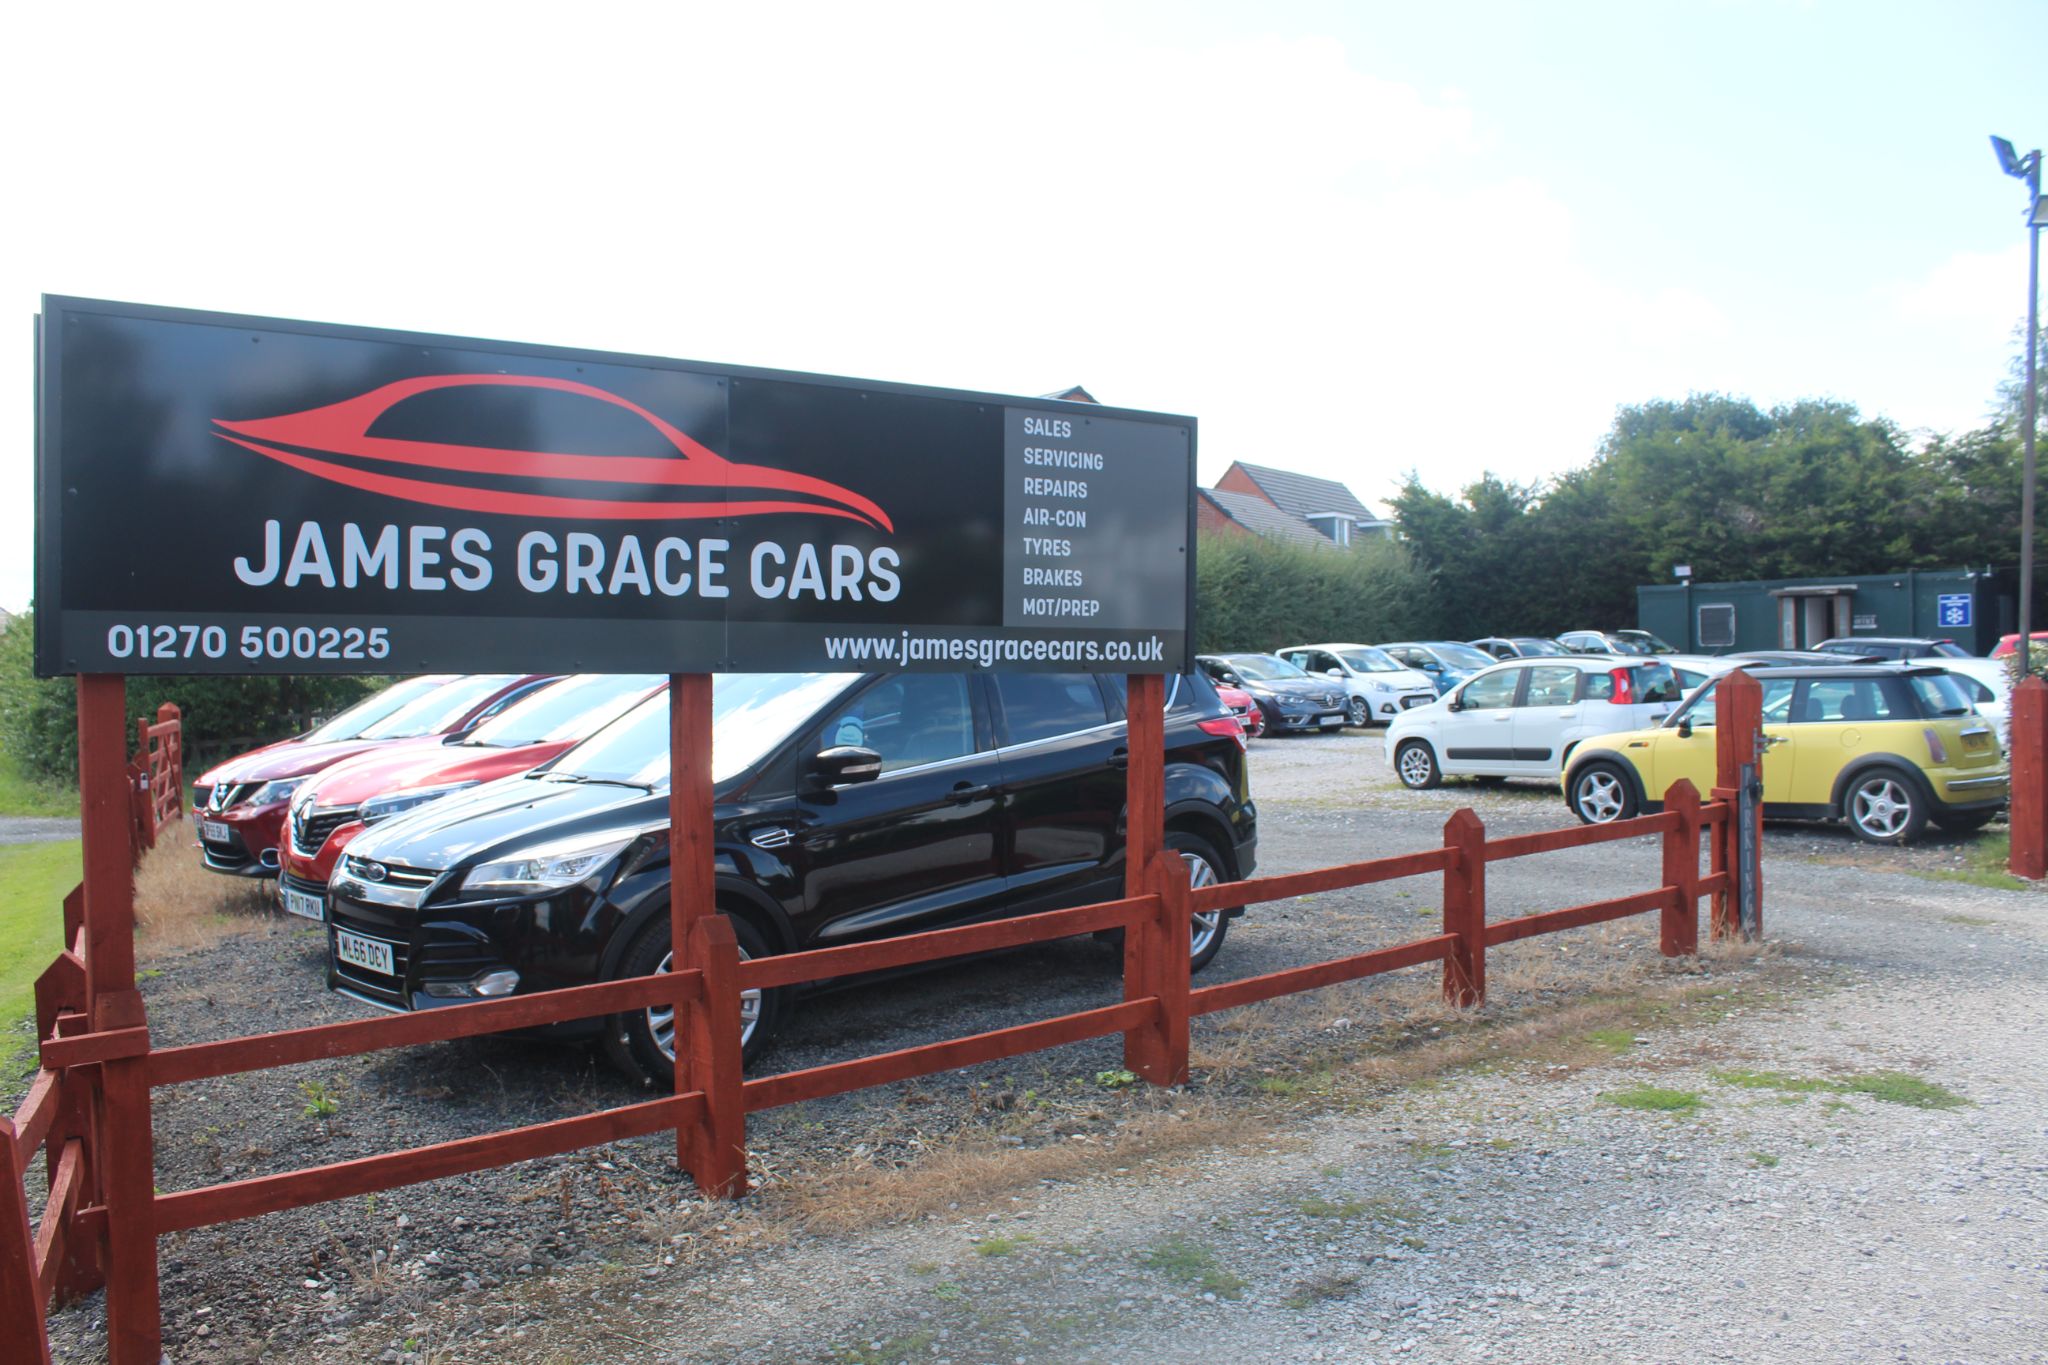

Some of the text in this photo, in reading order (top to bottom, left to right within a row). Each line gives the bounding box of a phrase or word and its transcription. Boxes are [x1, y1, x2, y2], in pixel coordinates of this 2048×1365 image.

[1024, 417, 1072, 438] SALES
[1023, 447, 1104, 470] SERVICING
[1024, 477, 1088, 498] REPAIRS
[1023, 507, 1086, 528] AIR-CON
[1023, 537, 1071, 557] TYRES
[233, 519, 901, 602] JAMES GRACE CARS
[1023, 567, 1083, 587] BRAKES
[1023, 597, 1100, 617] MOT/PREP
[107, 624, 390, 659] 01270 500225
[825, 630, 1164, 667] www.jamesgracecars.co.uk
[341, 935, 366, 963] ML66
